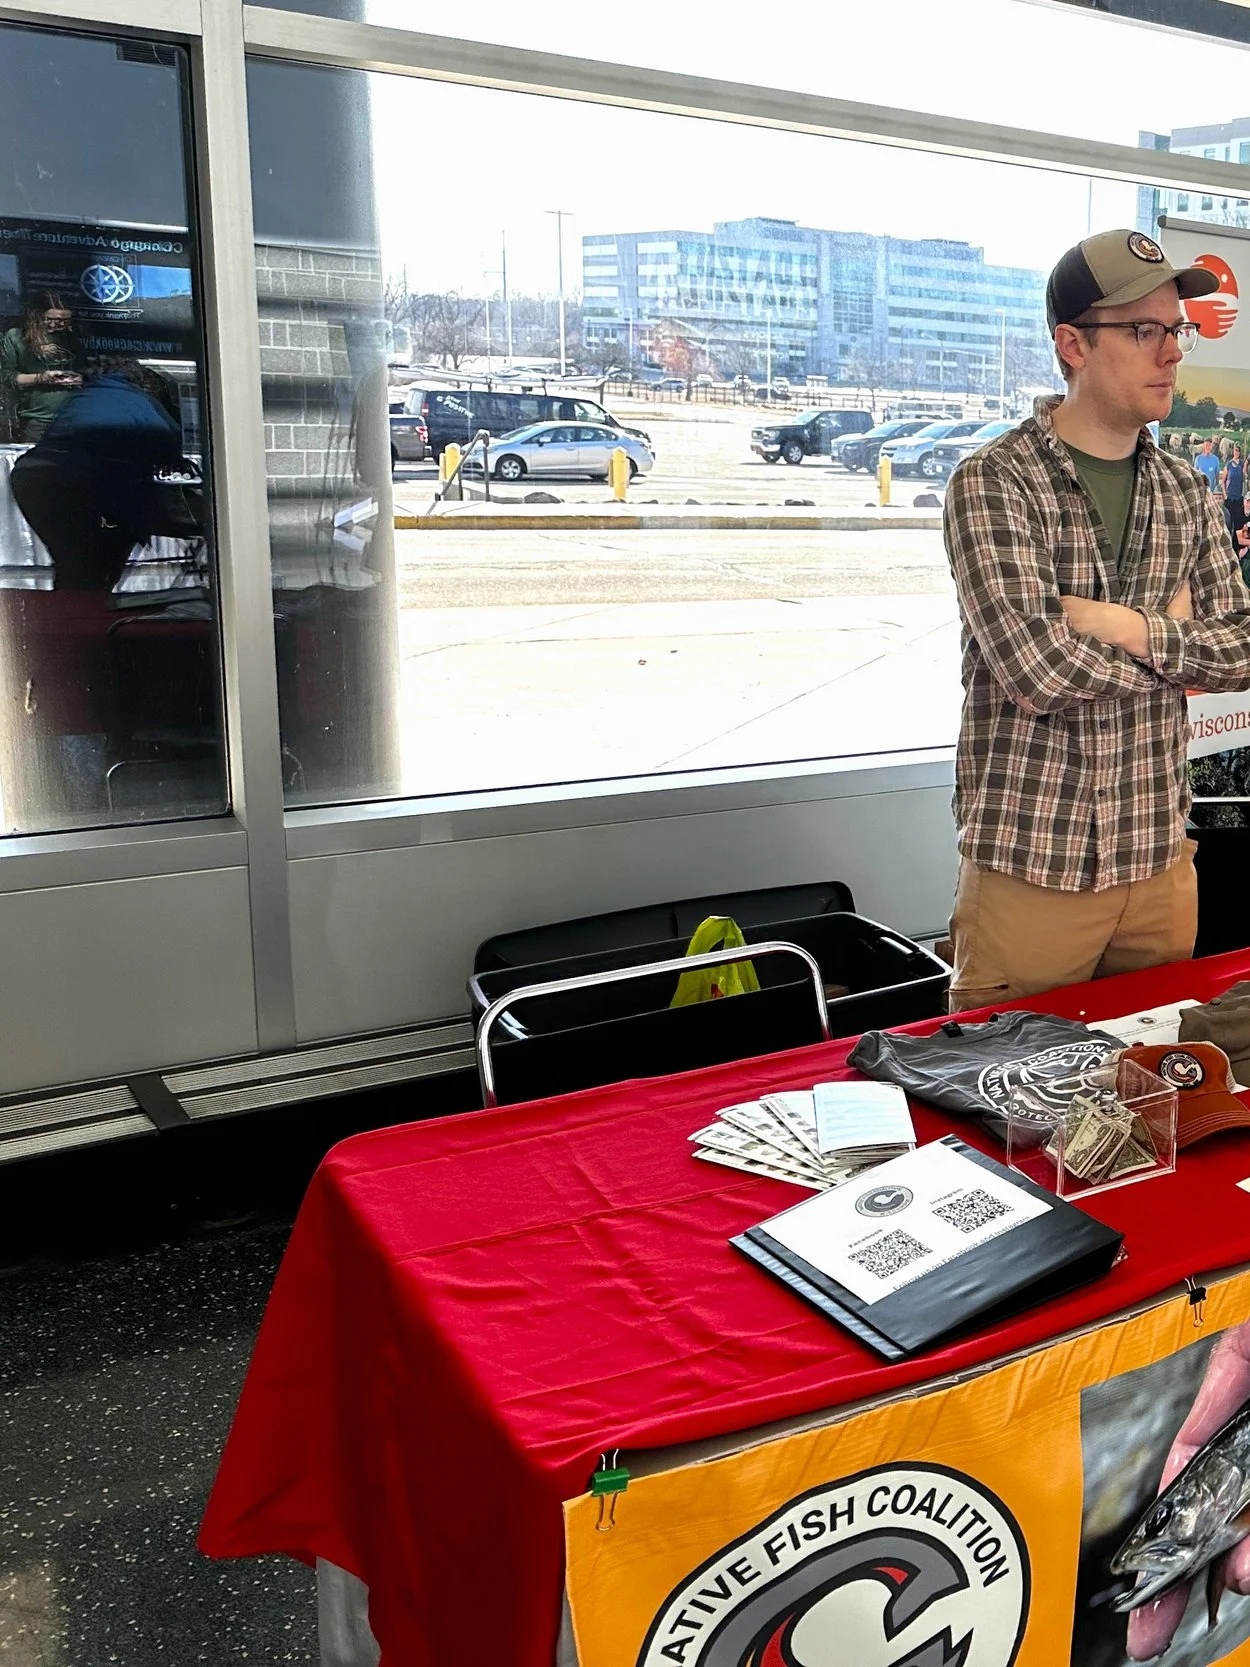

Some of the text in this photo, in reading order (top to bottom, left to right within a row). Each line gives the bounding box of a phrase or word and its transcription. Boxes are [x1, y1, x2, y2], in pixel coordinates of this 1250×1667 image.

[929, 1187, 964, 1206] Instagram
[848, 1228, 884, 1249] Facebook
[660, 1483, 1011, 1667] ATIVE FISH COALITION
